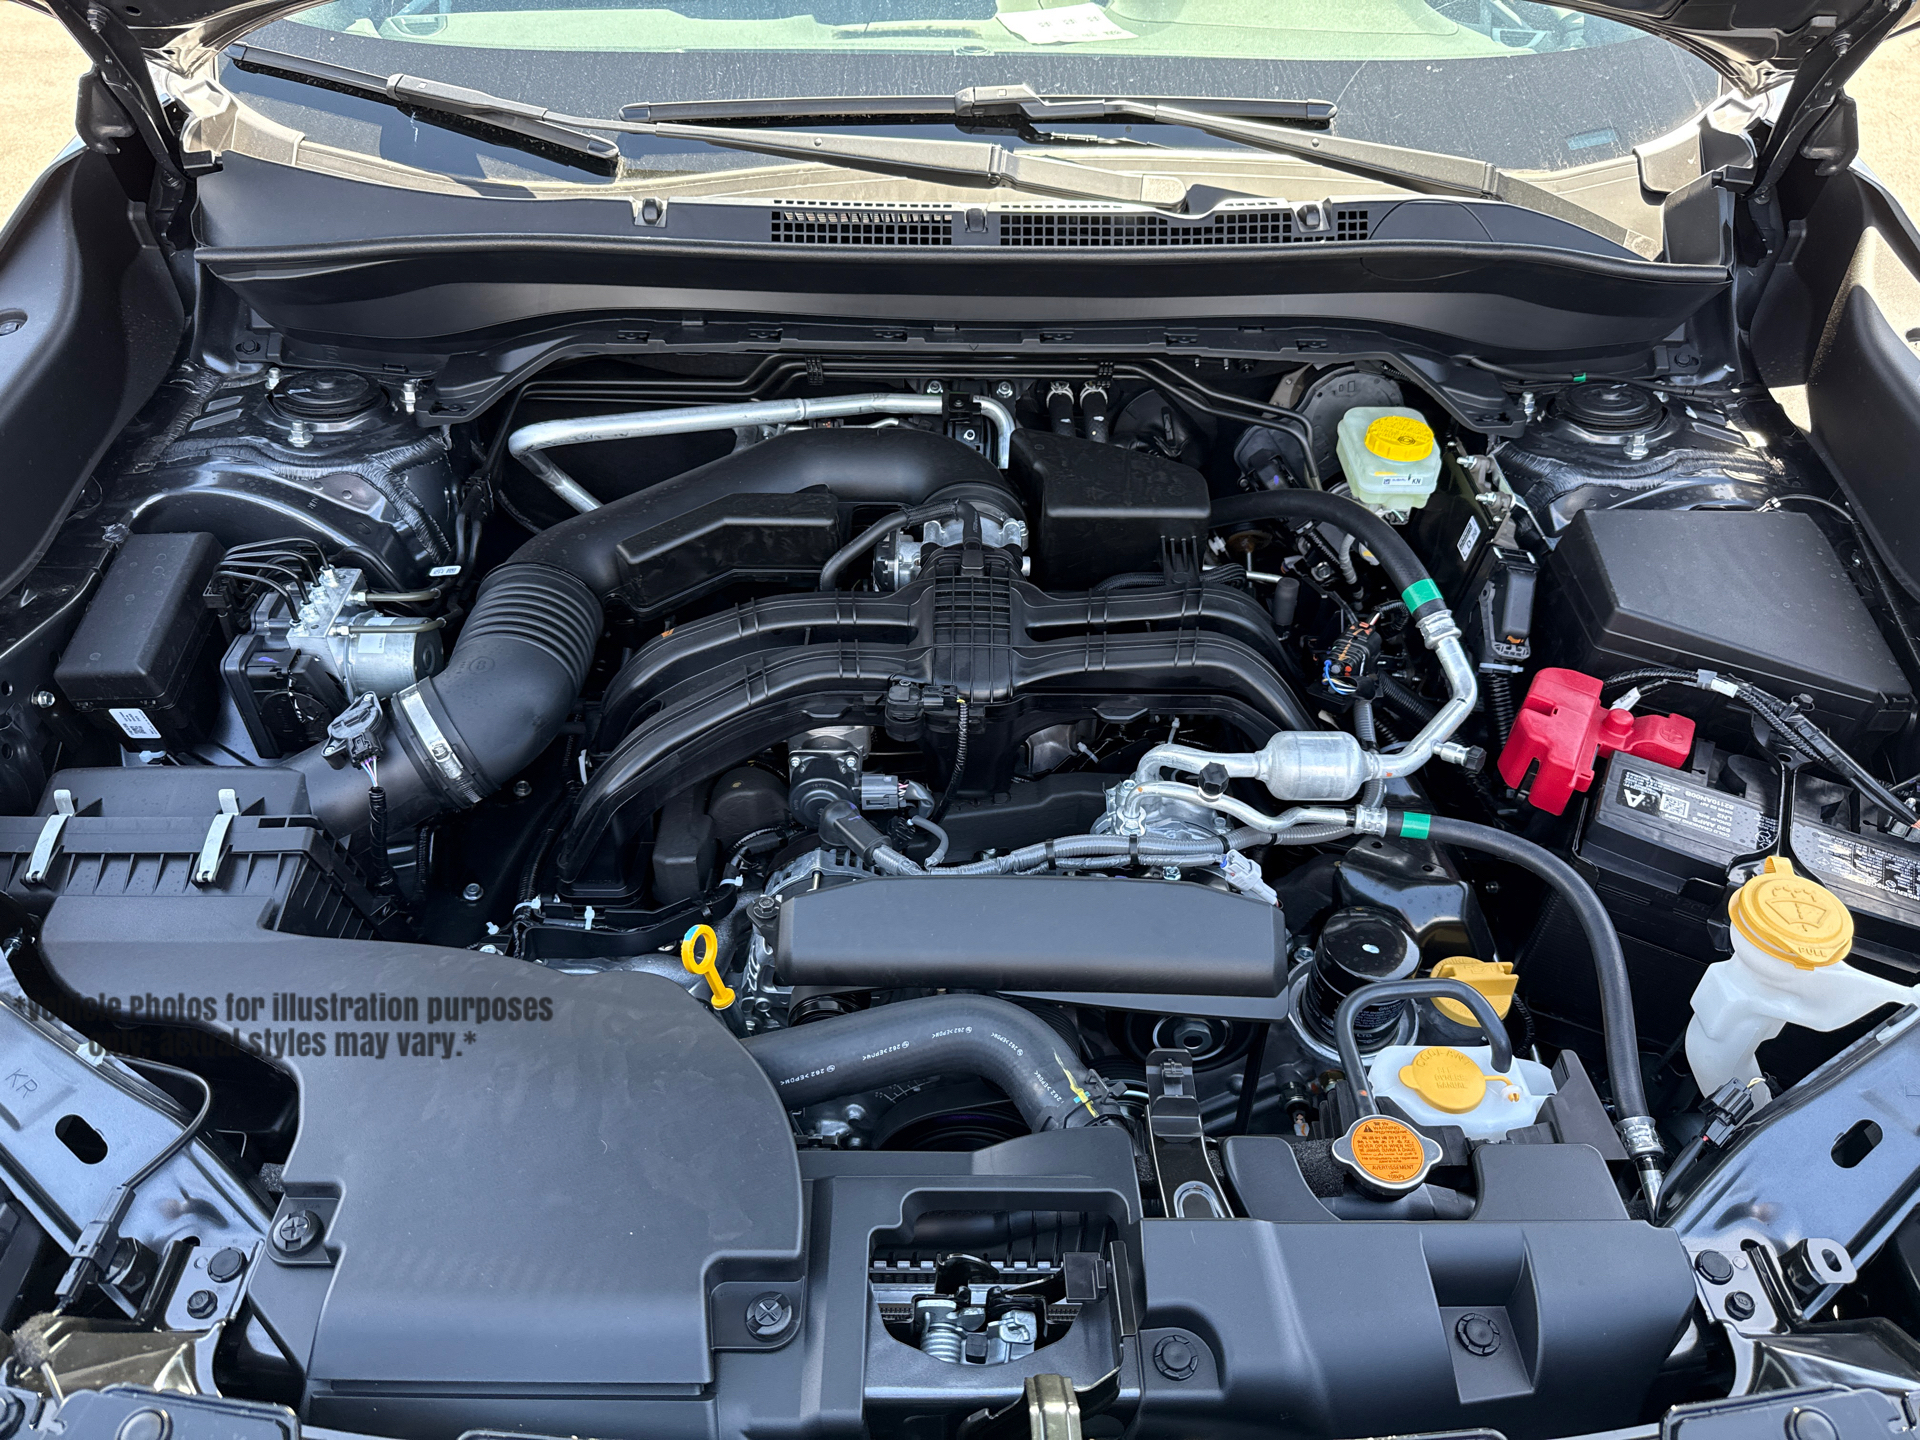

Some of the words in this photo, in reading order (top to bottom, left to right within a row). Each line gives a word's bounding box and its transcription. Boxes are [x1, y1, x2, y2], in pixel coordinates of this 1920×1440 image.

[1710, 817, 1732, 827] GROUP
[1716, 812, 1733, 822] LN2
[1681, 819, 1712, 832] CRANKING
[1692, 817, 1715, 828] AMPS
[1713, 829, 1730, 838] COLD
[1716, 824, 1731, 833] 620
[1798, 946, 1828, 958] PULL
[1415, 1048, 1473, 1068] COOLANT
[4, 1067, 38, 1099] KR
[1436, 1081, 1468, 1090] MANUAL
